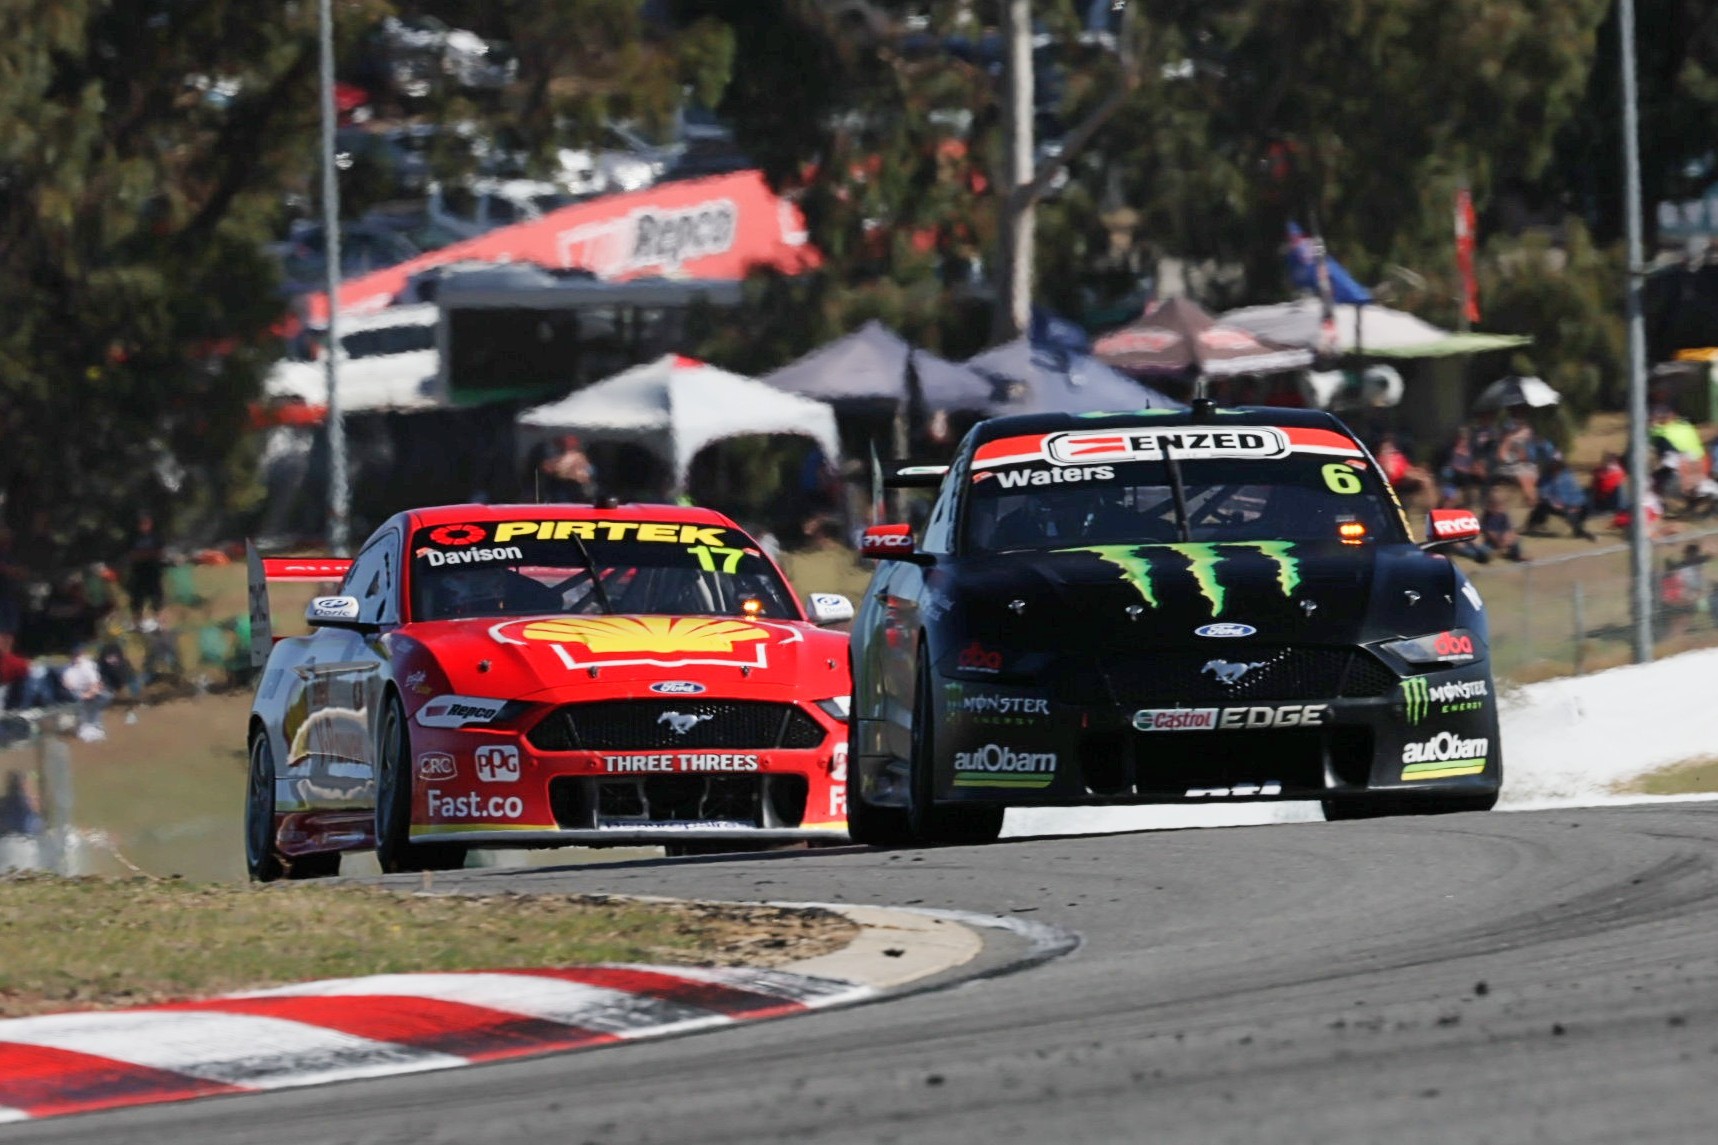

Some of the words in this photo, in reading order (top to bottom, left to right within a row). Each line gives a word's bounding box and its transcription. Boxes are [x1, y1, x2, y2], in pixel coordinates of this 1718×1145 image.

[632, 208, 733, 262] Repco
[1129, 433, 1265, 451] ENZED
[996, 464, 1115, 489] Waters
[1321, 463, 1362, 494] 6
[493, 521, 726, 547] PIRTEK
[1433, 517, 1481, 533] RYCO
[427, 546, 523, 567] Davison
[686, 545, 745, 575] 17
[314, 608, 351, 617] Doric
[1204, 625, 1243, 636] Ford
[1433, 630, 1474, 656] dba
[958, 642, 1003, 668] dba
[659, 682, 695, 692] Ford
[1429, 680, 1488, 703] MONSTER
[447, 703, 497, 719] Repco
[963, 693, 1050, 716] MONSTER
[1441, 701, 1483, 714] ENERGY
[1154, 711, 1213, 729] Castrol
[1218, 704, 1329, 729] EDGE
[420, 758, 453, 774] CRC
[477, 748, 519, 778] PPG
[603, 755, 673, 771] THREE
[677, 754, 758, 771] THREES
[427, 789, 524, 818] Fast.co
